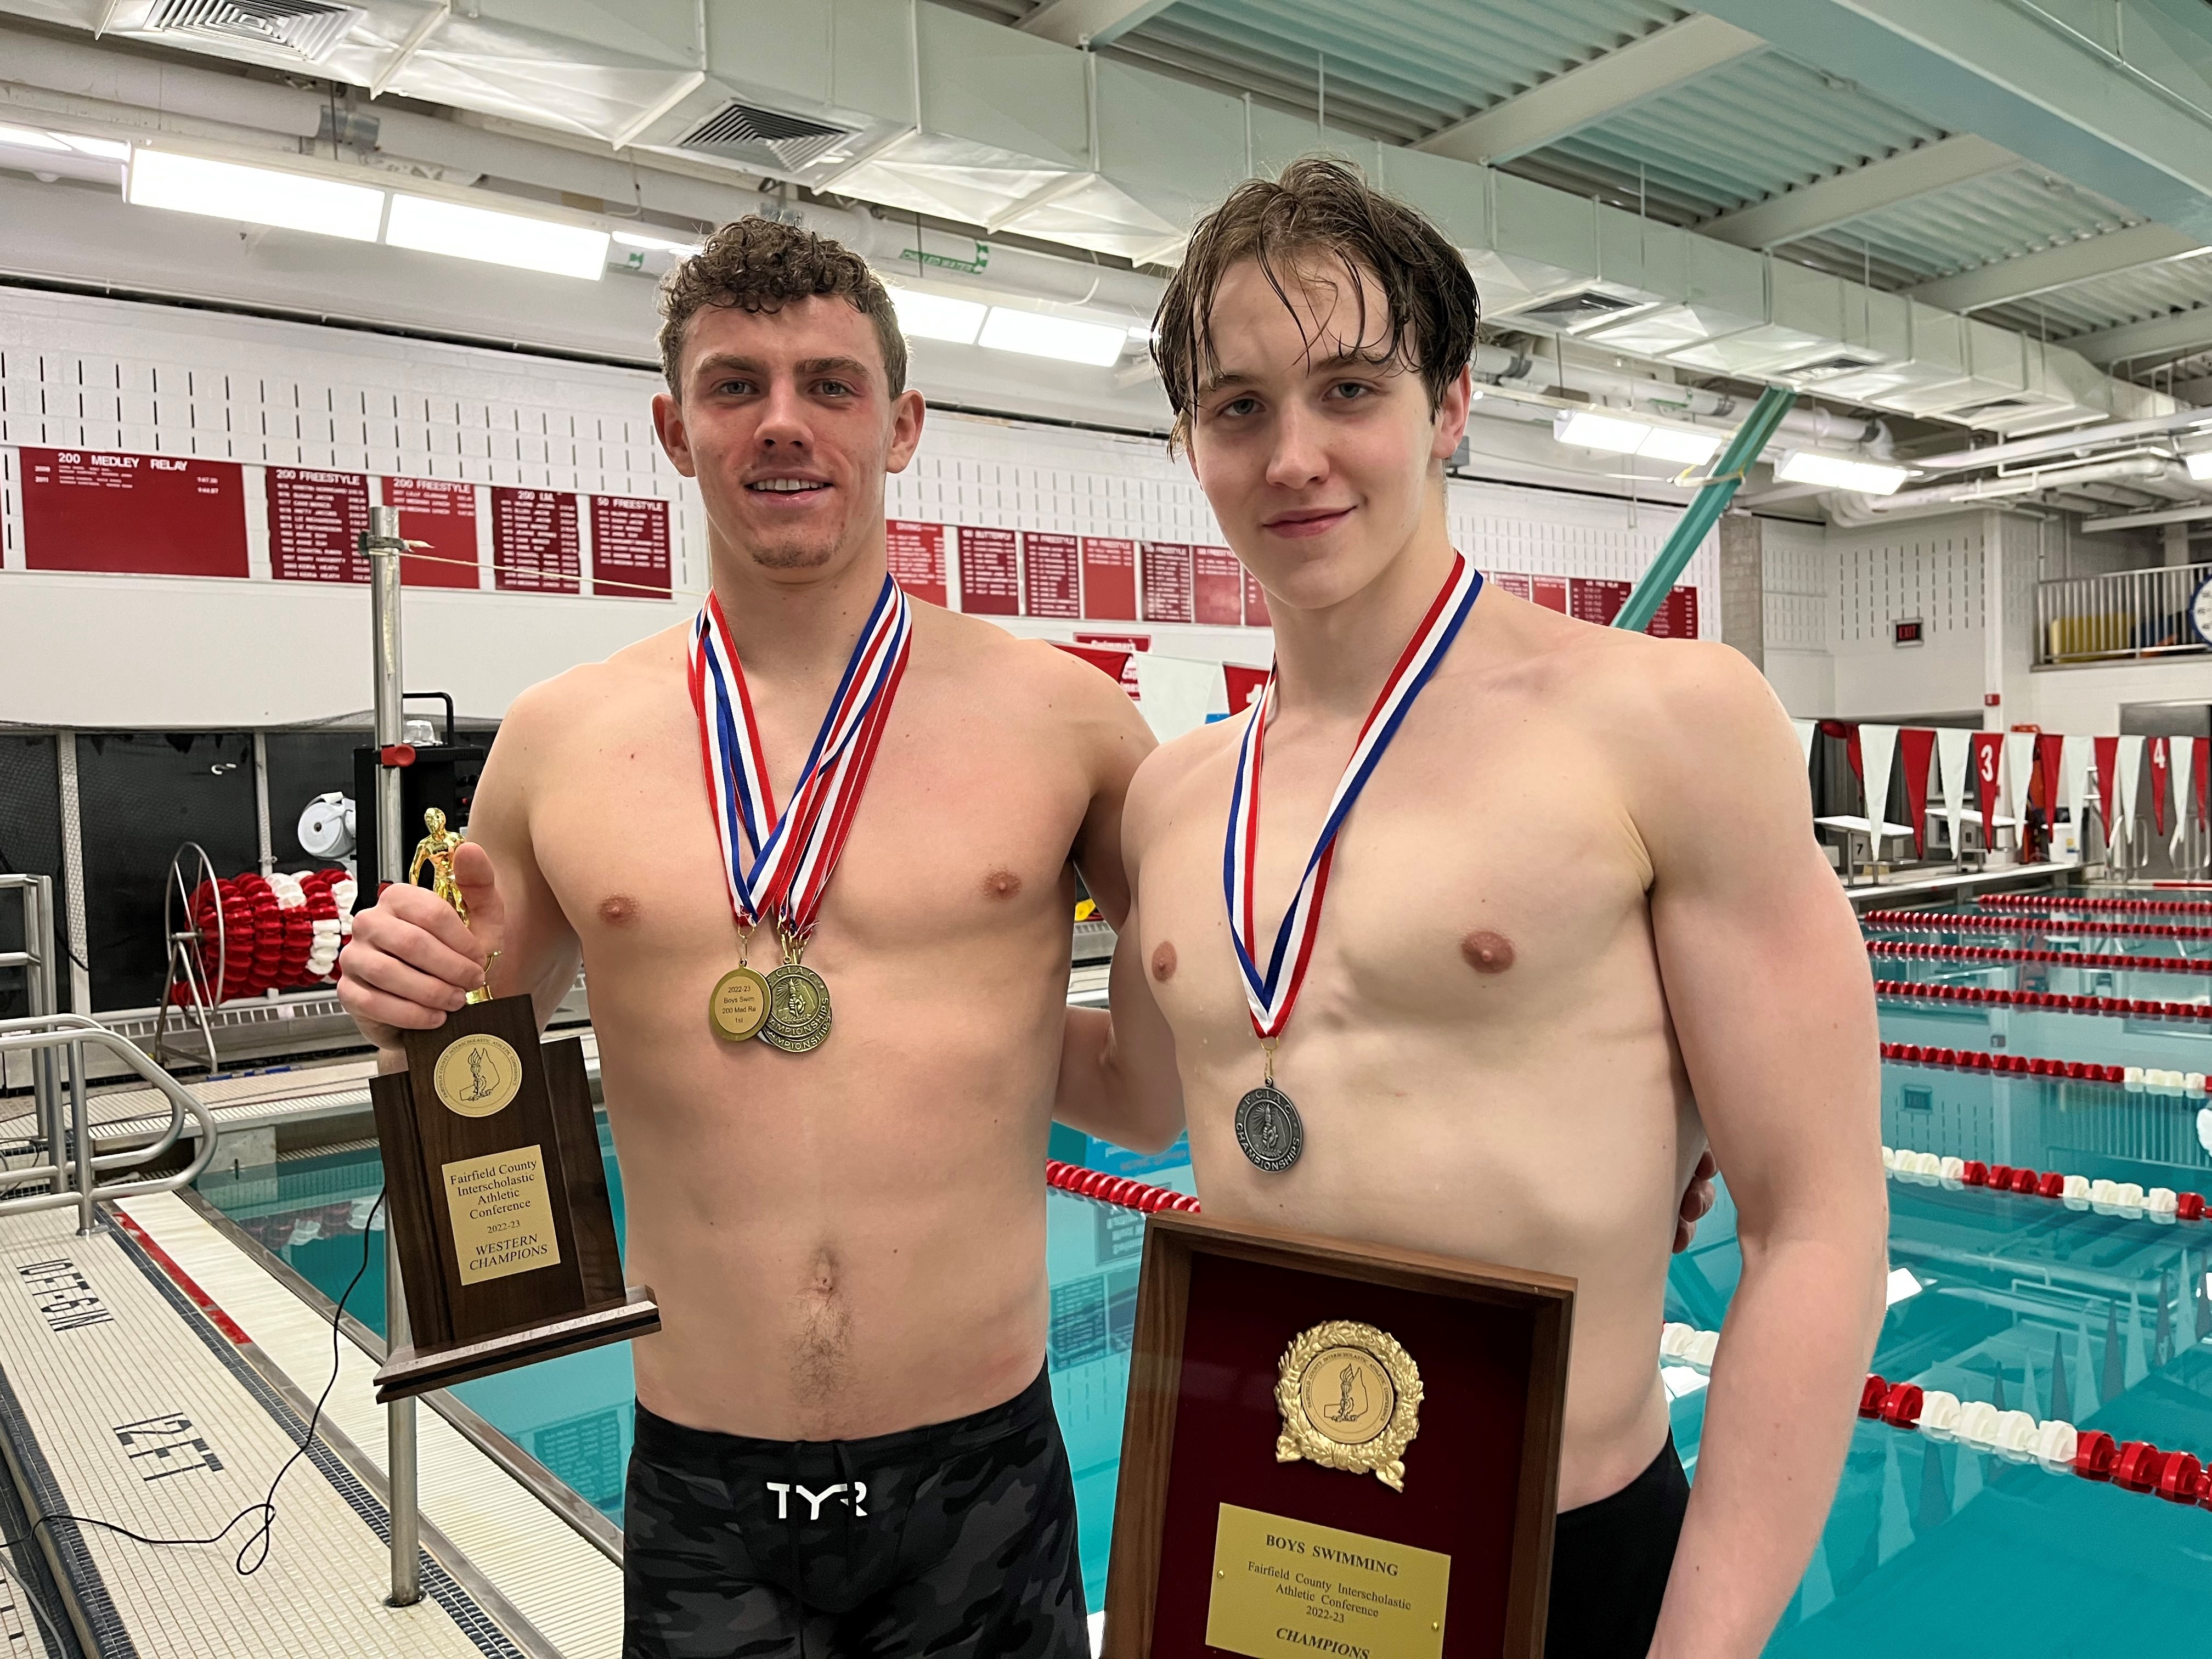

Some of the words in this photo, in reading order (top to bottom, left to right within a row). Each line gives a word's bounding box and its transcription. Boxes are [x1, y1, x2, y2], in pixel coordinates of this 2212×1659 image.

[58, 453, 80, 464] 200
[91, 455, 139, 468] MEDLEY
[150, 459, 188, 471] RELAY
[276, 469, 296, 479] 200
[300, 471, 360, 486] FREESTYLE
[393, 478, 413, 488] 200
[416, 480, 471, 493] FREESTYLE
[613, 498, 663, 512] FREESTYLE
[1981, 744, 1993, 782] 3
[2154, 737, 2165, 769] 4
[1857, 843, 1863, 855] 7
[768, 997, 829, 1035] AMPIONSHIPS
[768, 1016, 832, 1050] AMPIONSHIPS
[1236, 1122, 1300, 1170] CHAMPIONSHIPS
[450, 1167, 496, 1185] Fairfield
[499, 1160, 537, 1174] County
[458, 1172, 535, 1197] Interscholastic
[478, 1188, 520, 1205] Athletic
[470, 1200, 531, 1219] Conference
[487, 1220, 521, 1233] 2022-23
[476, 1233, 538, 1255] WESTERN
[470, 1244, 548, 1271] CHAMPIONS
[766, 1481, 868, 1520] TYR
[1266, 1534, 1305, 1554] BOYS
[1313, 1545, 1398, 1577] SWIMMING
[1248, 1561, 1290, 1581] Fairfield
[1296, 1573, 1332, 1592] County
[1338, 1583, 1411, 1610] Interscholastic
[1276, 1583, 1315, 1601] Athletic
[1321, 1594, 1379, 1617] Conference
[1306, 1605, 1345, 1624] 2022-23
[1276, 1627, 1370, 1659] CHAMPIONS
